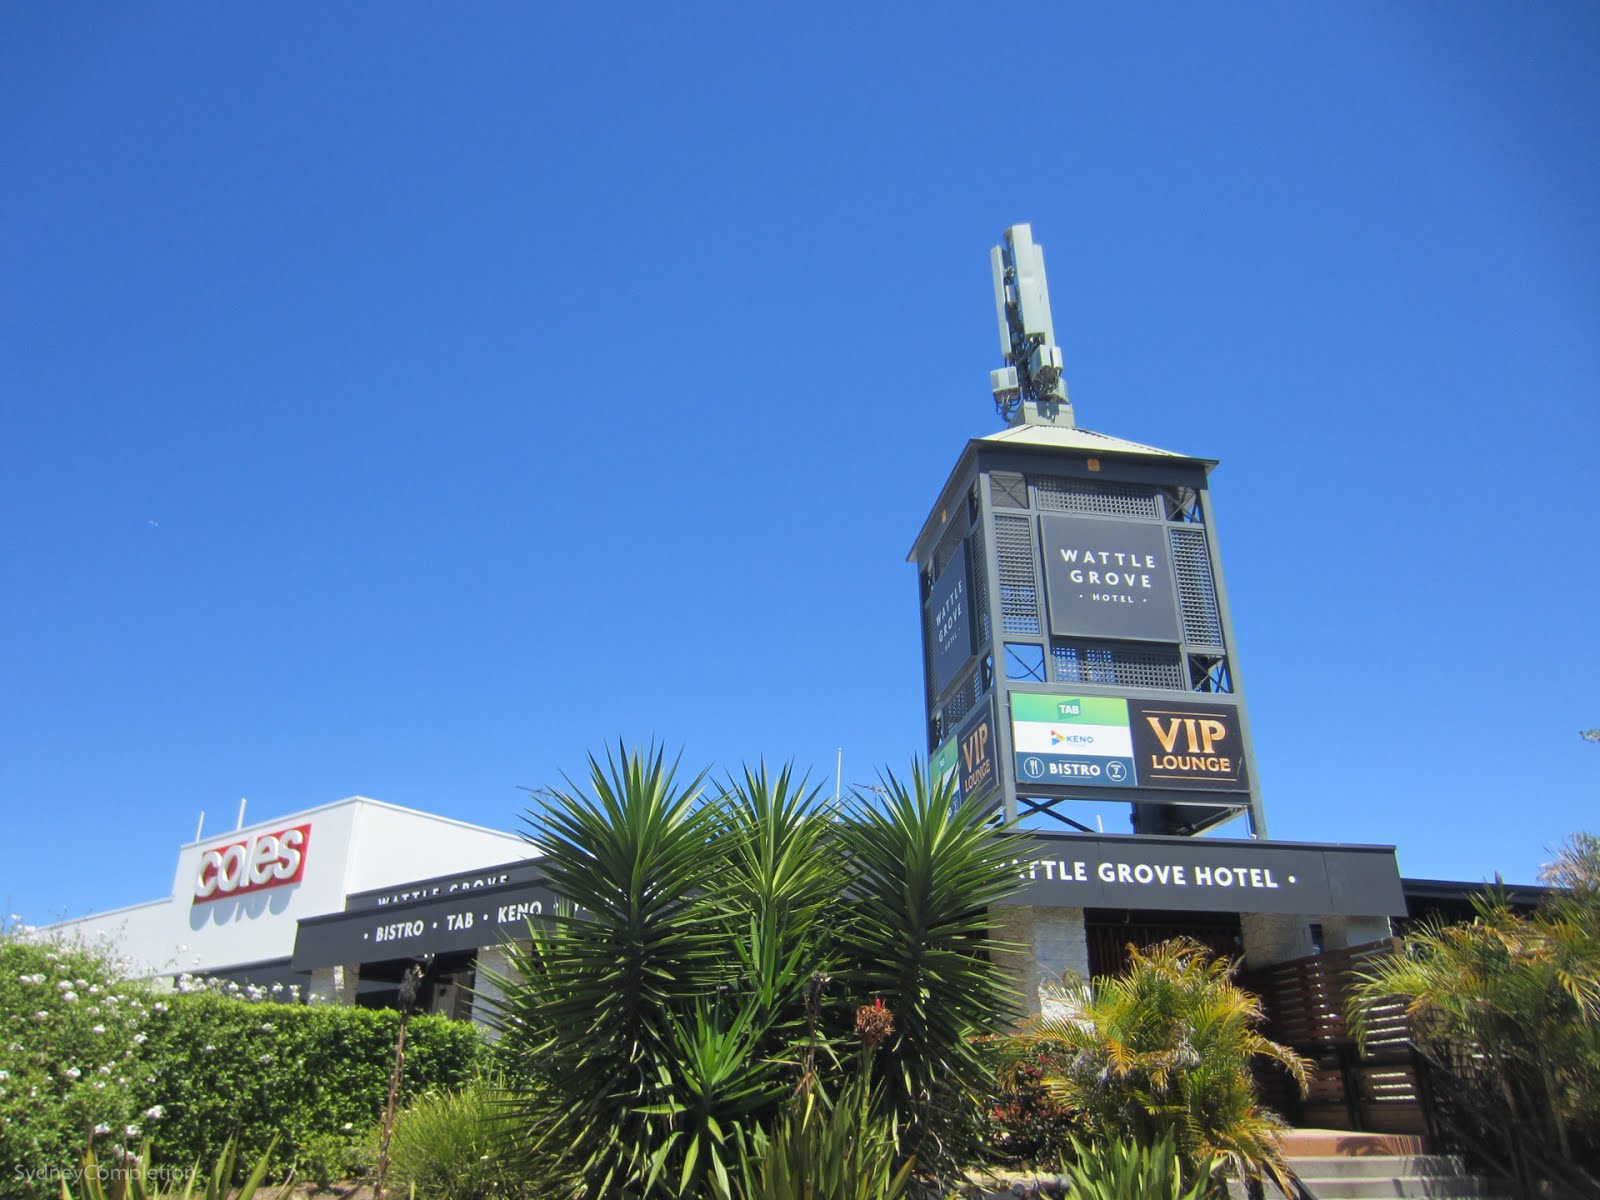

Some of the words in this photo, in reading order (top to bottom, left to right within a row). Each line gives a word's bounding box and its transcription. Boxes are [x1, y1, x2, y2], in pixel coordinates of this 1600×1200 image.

[1060, 548, 1156, 569] WATTLE
[1070, 569, 1152, 588] GROVE
[936, 580, 963, 627] WATTLE
[1092, 593, 1134, 603] HOTEL
[938, 603, 962, 642] GROVE
[1058, 704, 1080, 715] TAB
[962, 722, 988, 773] VIP
[1066, 735, 1094, 744] KENO
[1146, 716, 1226, 754] VIP
[964, 759, 991, 793] LOUNGE
[1049, 763, 1101, 776] BISTRO
[1151, 754, 1232, 772] LOUNGE
[195, 829, 304, 898] coles
[1098, 862, 1187, 886] GROVE
[1194, 866, 1279, 889] HOTEL
[375, 919, 424, 942] BISTRO
[447, 911, 474, 931] TAB
[498, 900, 542, 924] KENO
